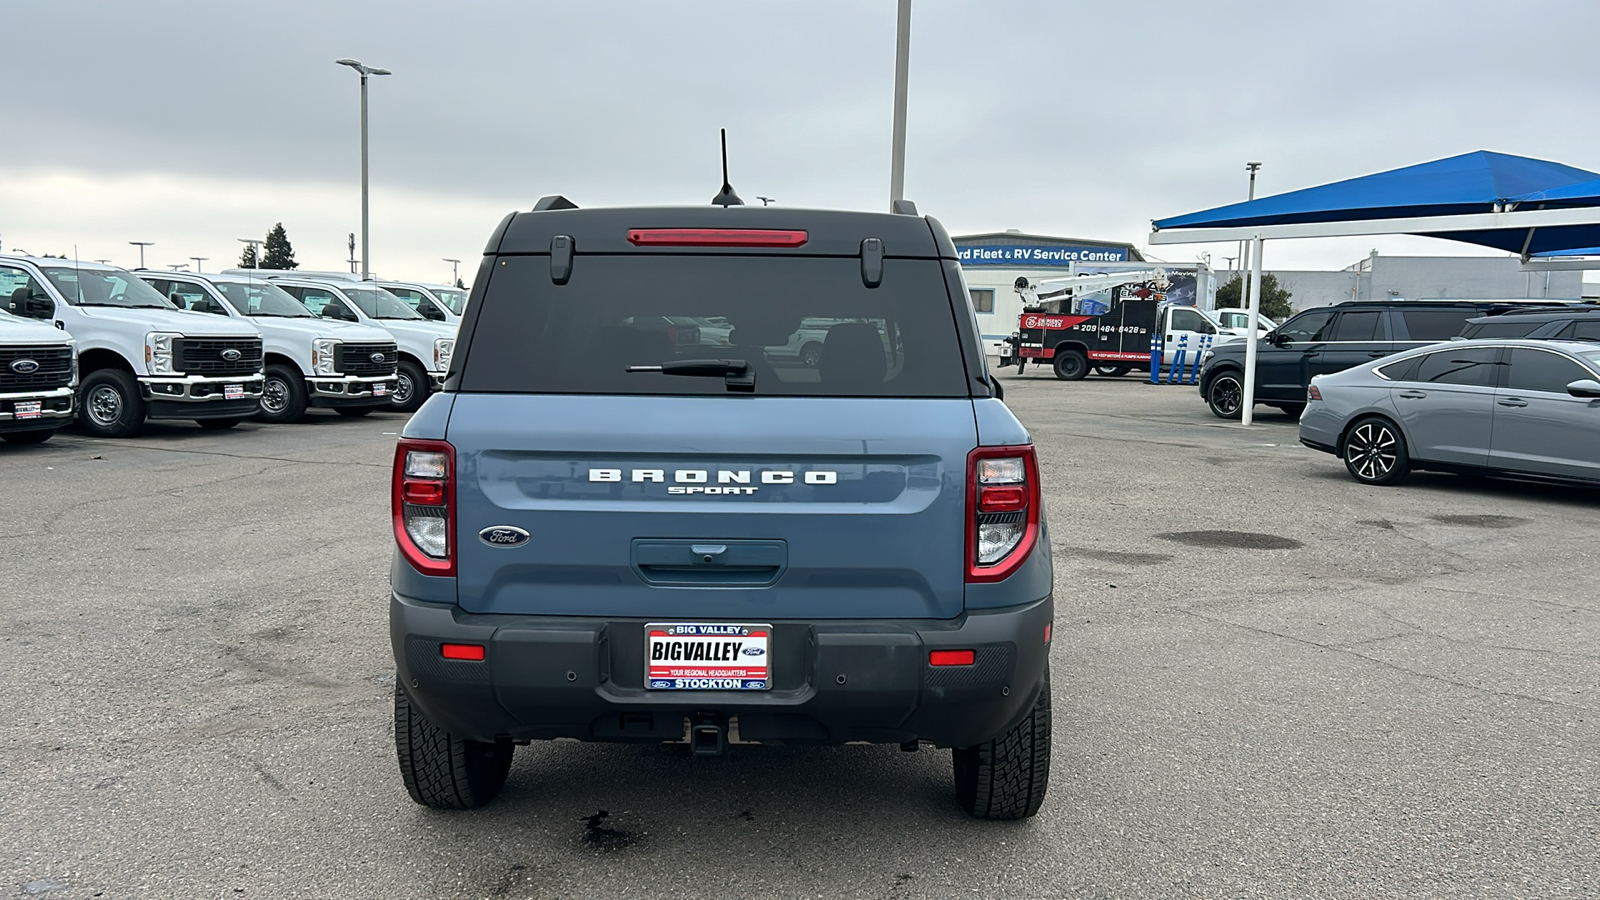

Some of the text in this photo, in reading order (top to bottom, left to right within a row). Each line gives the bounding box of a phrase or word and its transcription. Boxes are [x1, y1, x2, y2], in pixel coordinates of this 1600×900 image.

[959, 249, 1122, 261] rd Fleet & RV Service Center
[589, 469, 837, 484] BRONCO
[668, 486, 758, 495] SPORT
[676, 626, 741, 634] BIG VALLEY
[651, 641, 743, 661] BIGVALLEY
[685, 669, 708, 677] REGIONAL
[708, 669, 747, 677] HEADQUARTERS
[675, 679, 740, 688] STOCKTON
